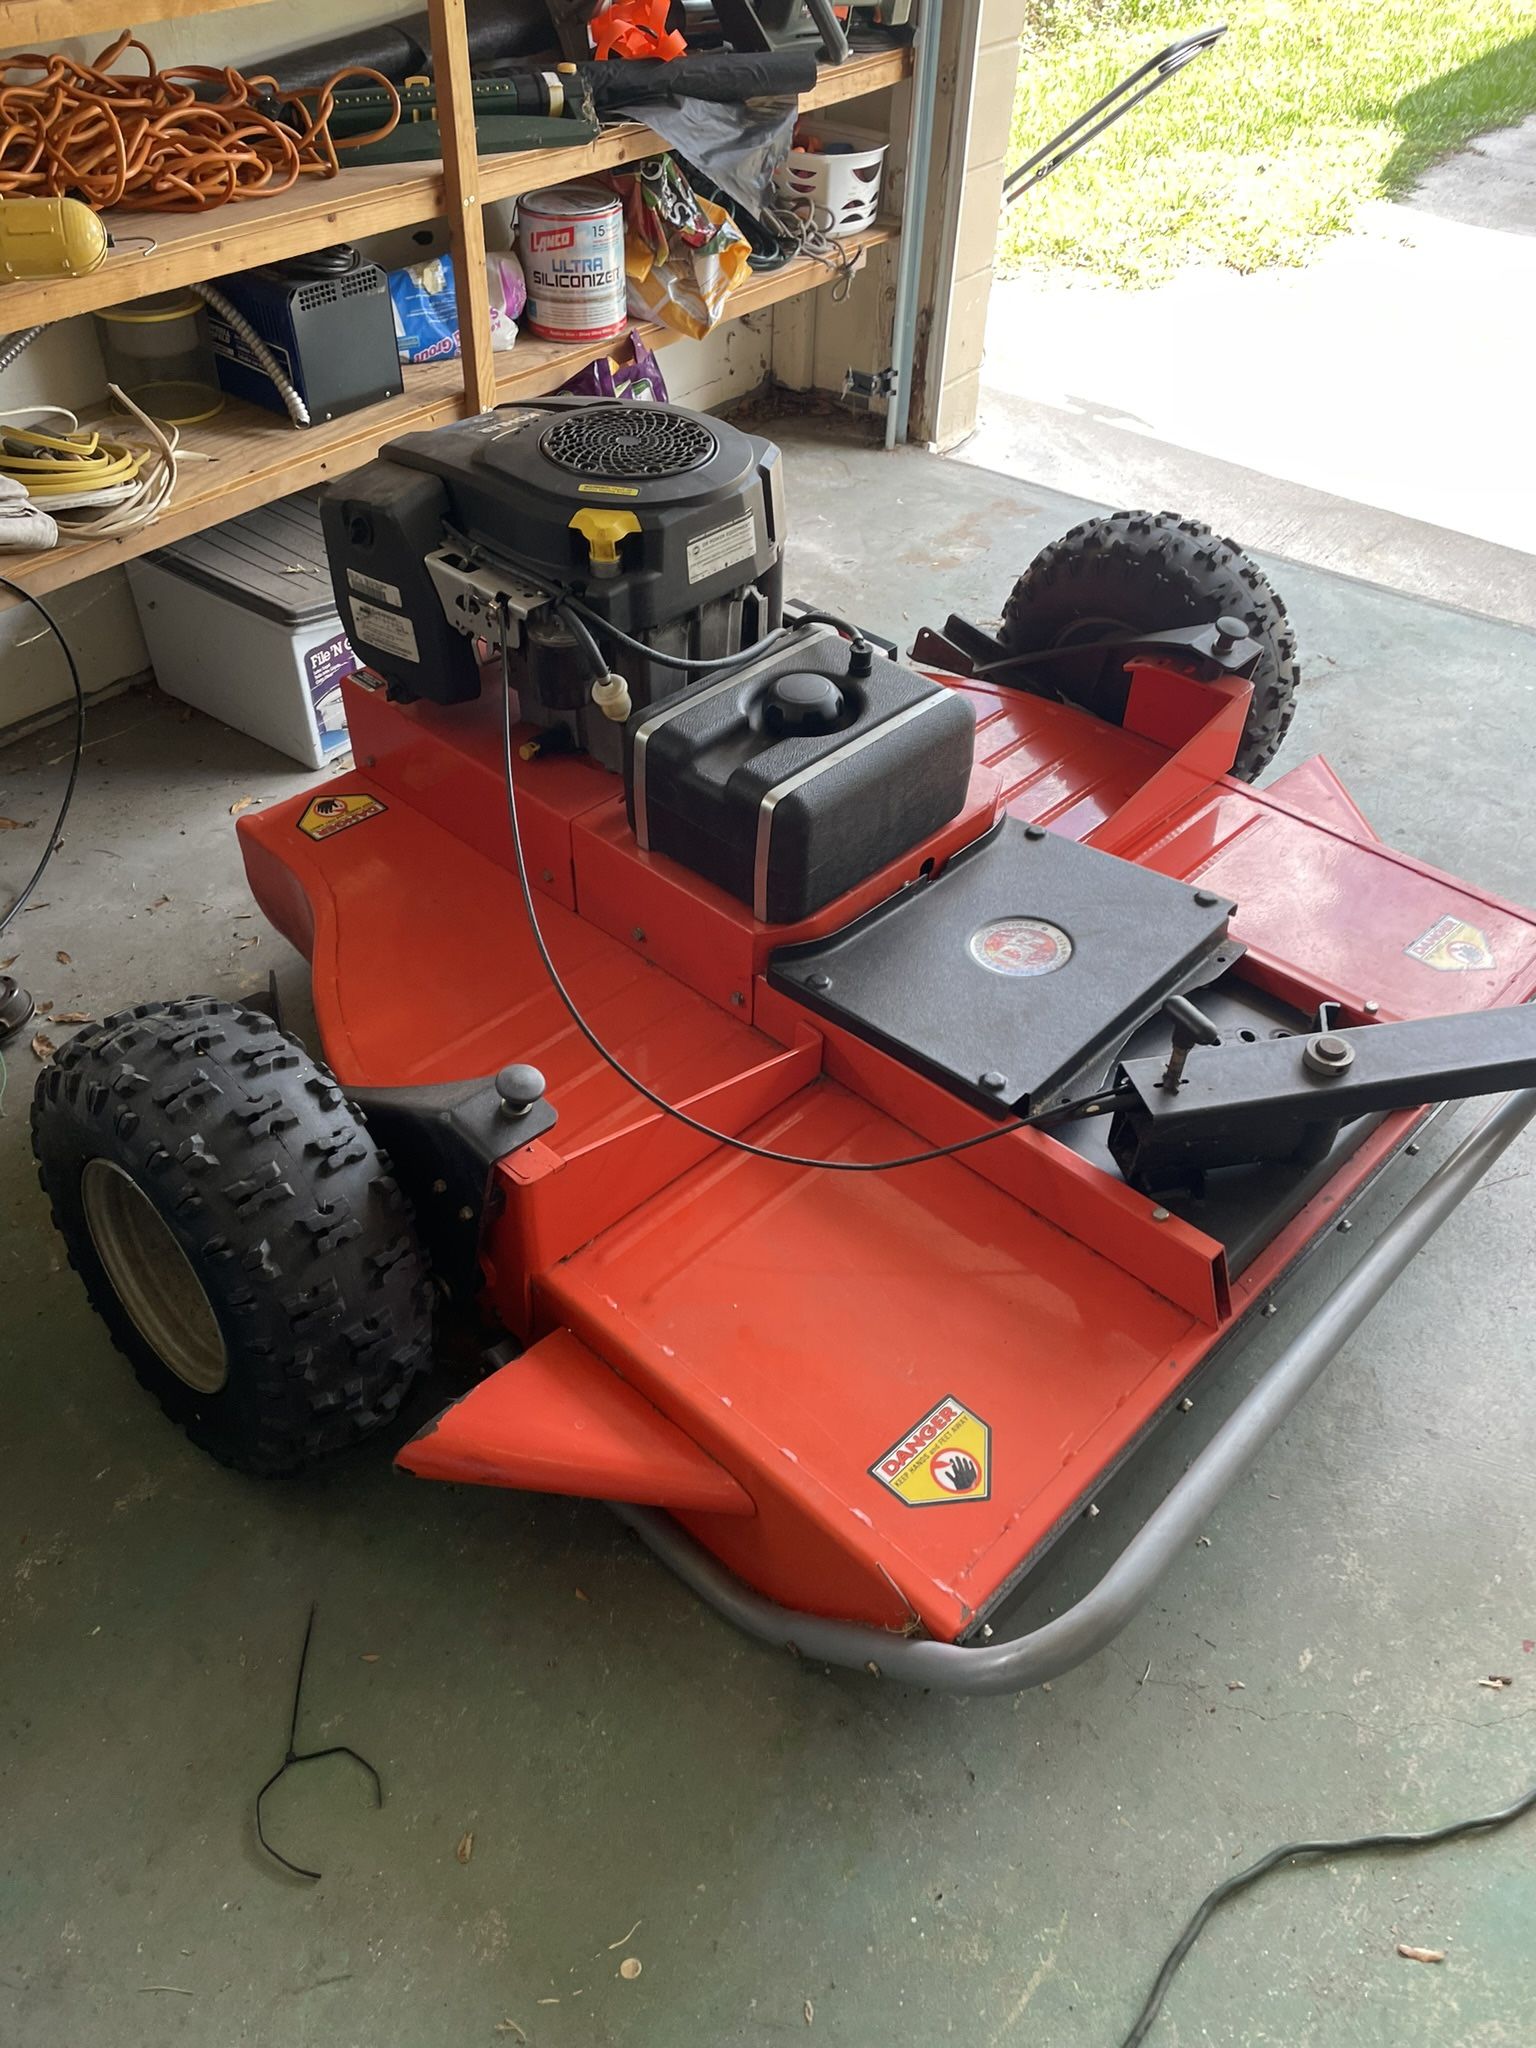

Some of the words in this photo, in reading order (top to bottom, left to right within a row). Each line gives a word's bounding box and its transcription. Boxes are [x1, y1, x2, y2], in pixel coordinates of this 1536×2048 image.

[592, 225, 606, 238] 15
[551, 257, 603, 273] ULTRA
[310, 650, 331, 669] File
[881, 1406, 958, 1478] DANGER
[894, 1472, 909, 1487] KEEP
[910, 1453, 930, 1473] HANDS
[939, 1431, 953, 1446] FEET
[951, 1415, 969, 1434] AWAY
